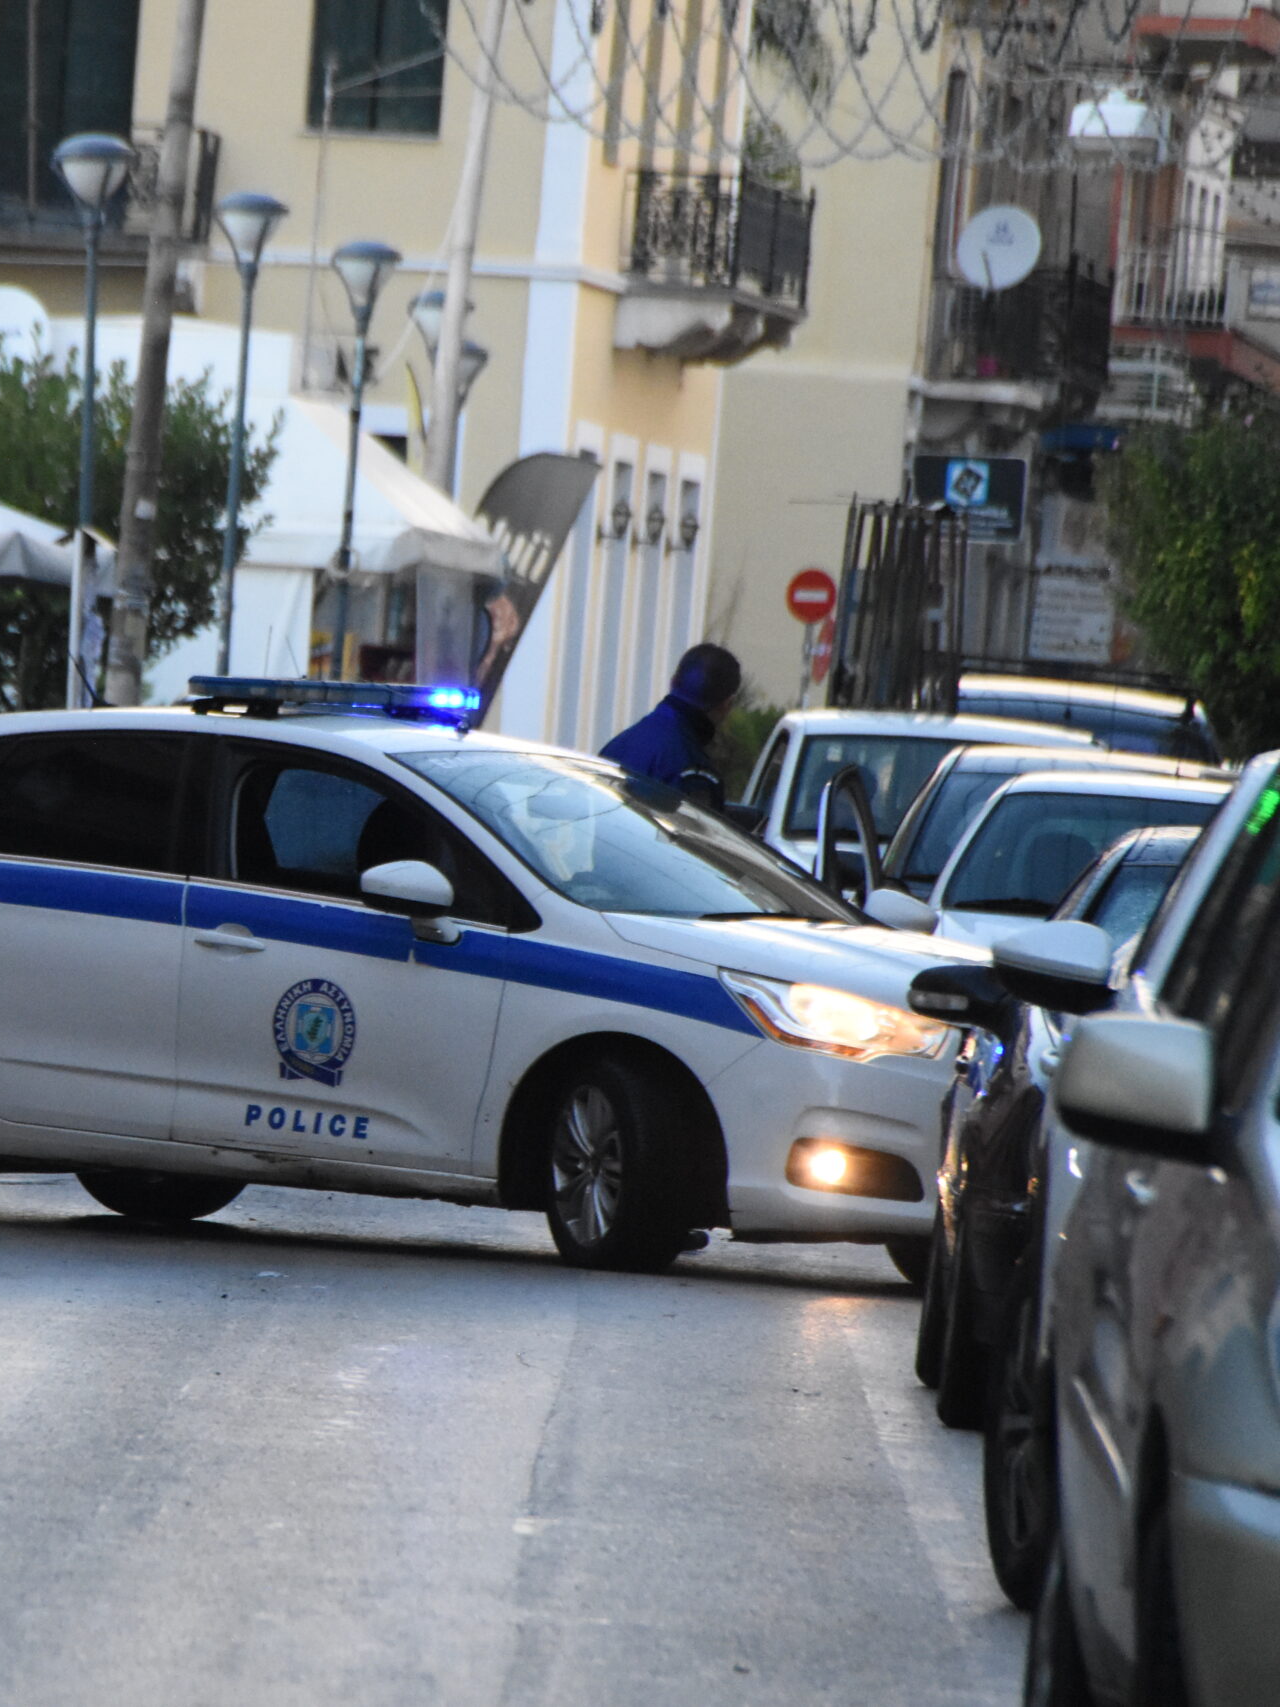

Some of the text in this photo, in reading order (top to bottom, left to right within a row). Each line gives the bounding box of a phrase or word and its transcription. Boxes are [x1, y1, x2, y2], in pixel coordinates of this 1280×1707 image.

[275, 981, 354, 1062] ΕΛΛΗΝΙΚΗ ΑΣΤΥΝΟΜΙΑ
[244, 1104, 370, 1140] POLICE
